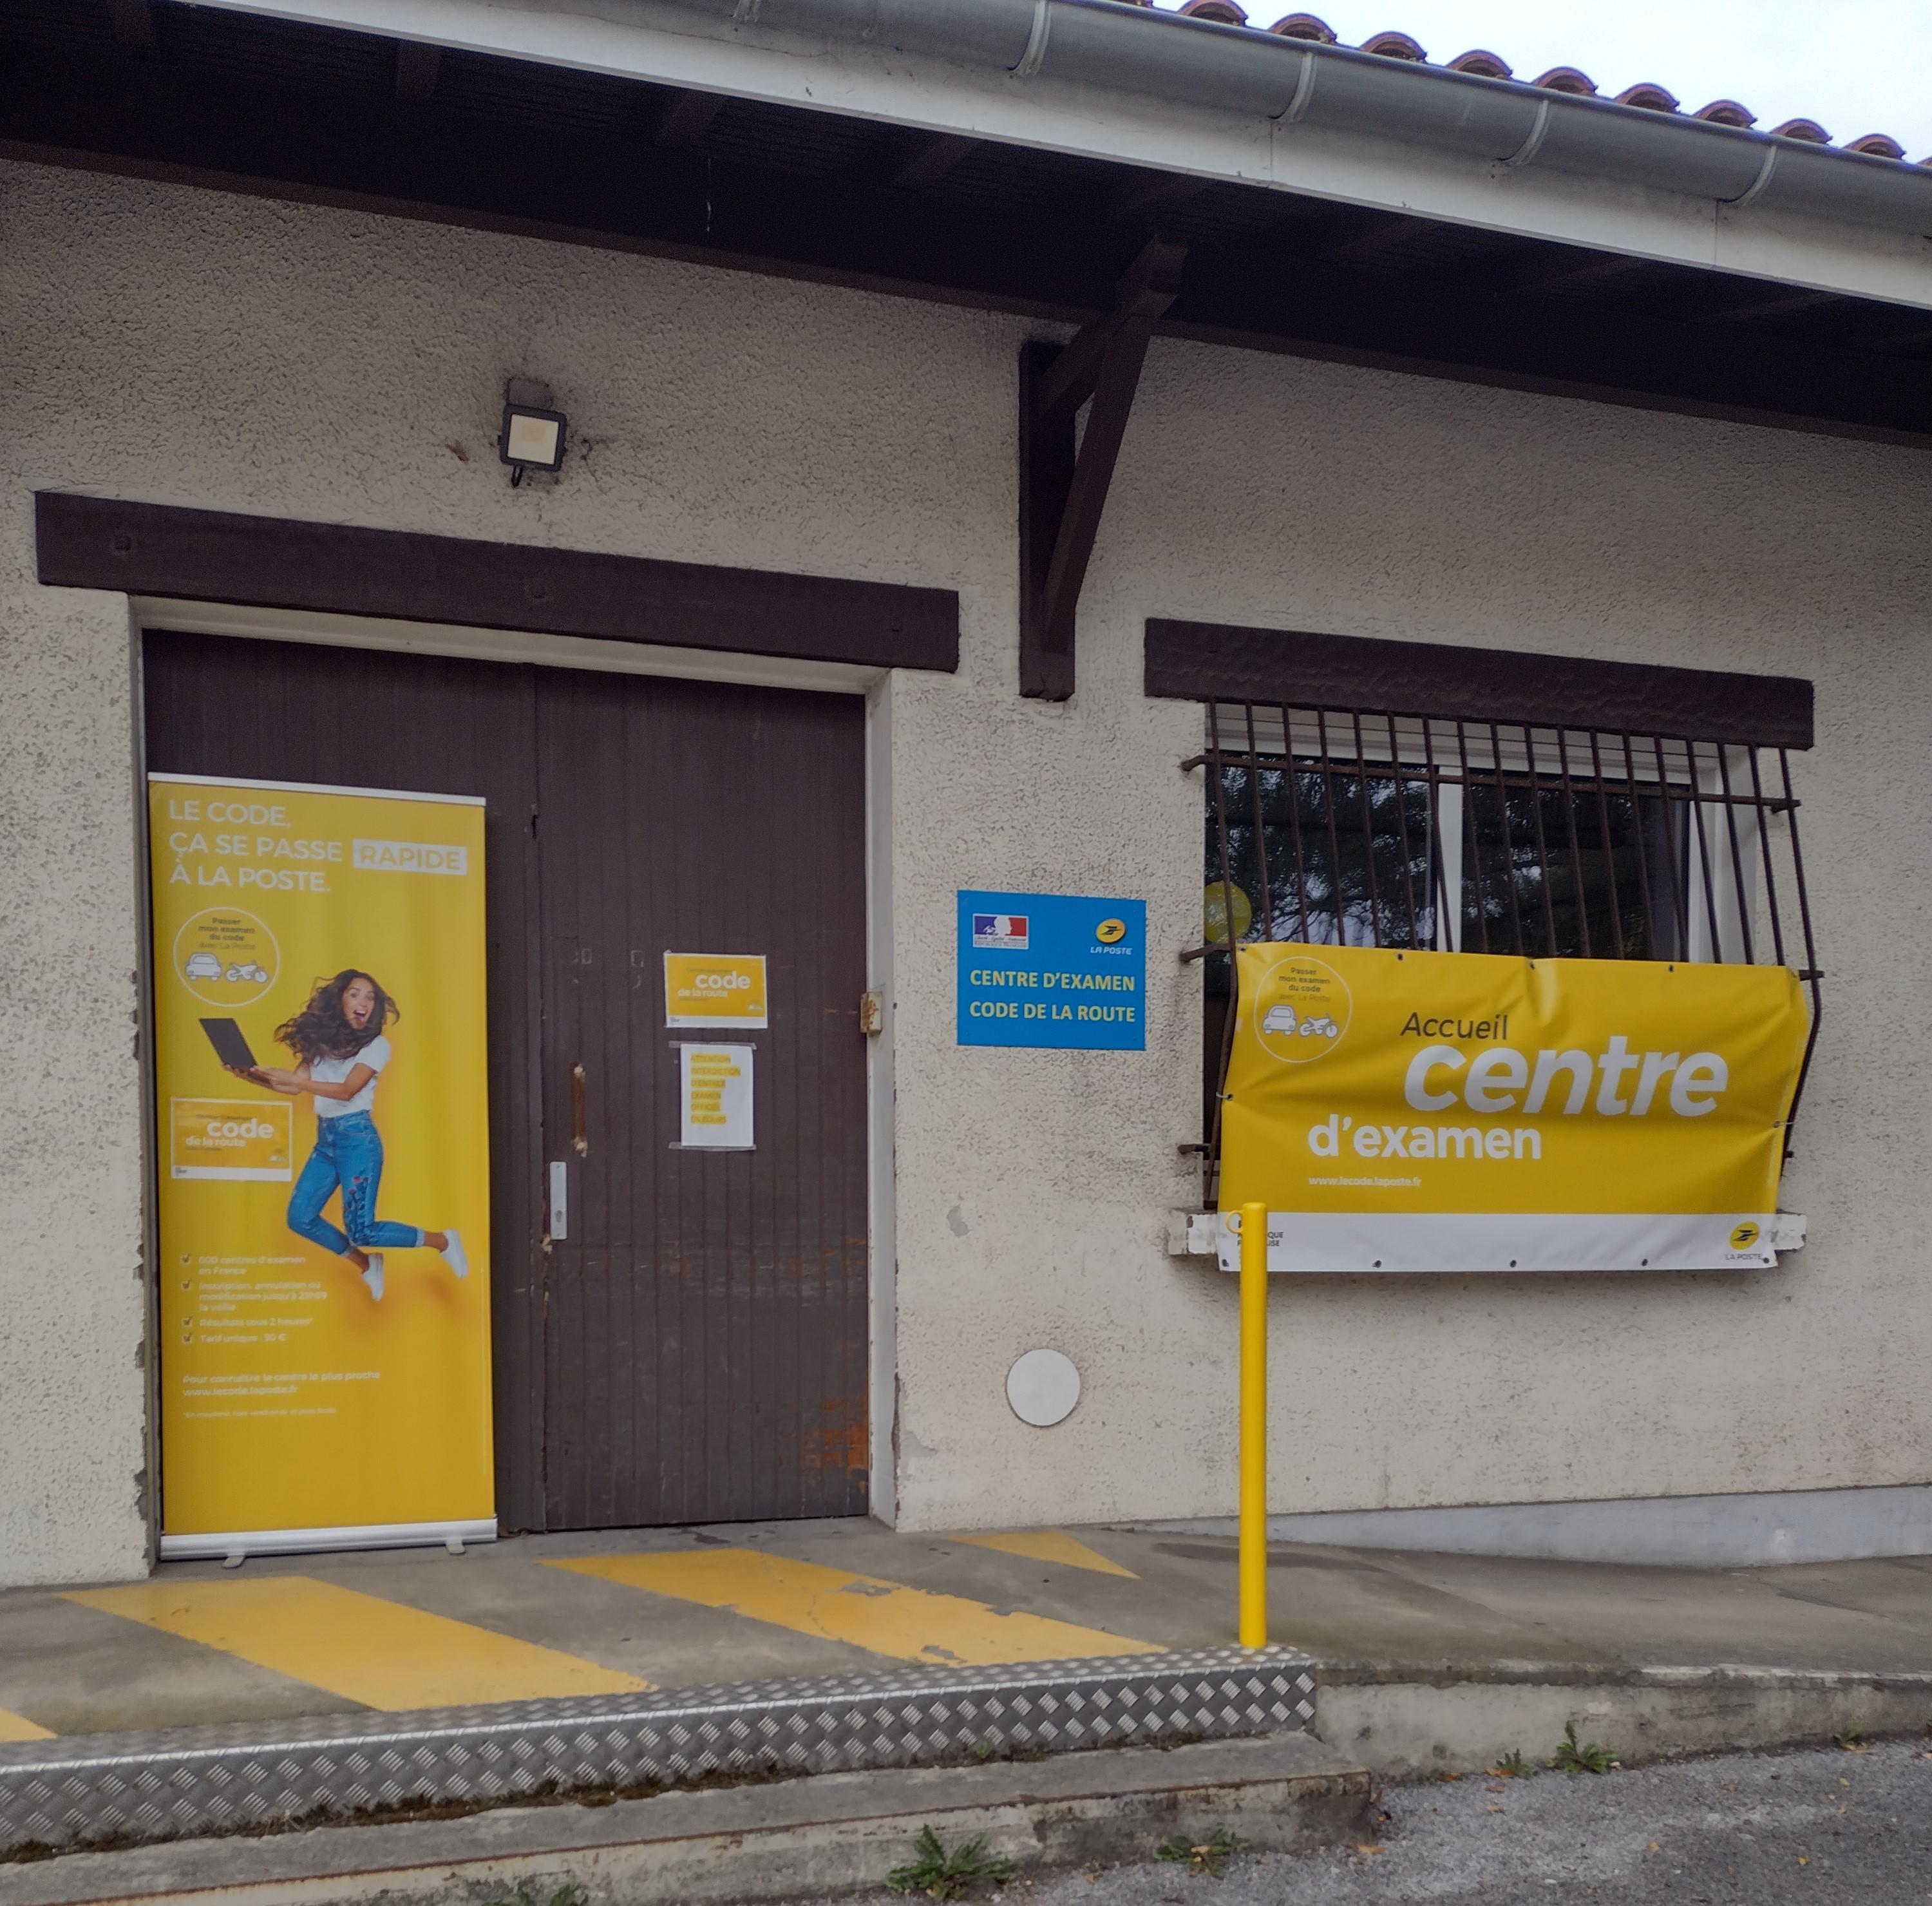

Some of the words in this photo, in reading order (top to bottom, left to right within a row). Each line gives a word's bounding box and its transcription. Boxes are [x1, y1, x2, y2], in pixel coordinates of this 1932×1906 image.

[169, 799, 200, 821] LE
[207, 802, 290, 828] CODE,
[169, 832, 208, 857] ÇA
[216, 835, 248, 856] SE
[258, 839, 342, 861] PASSE
[360, 844, 461, 870] RAPIDE
[170, 859, 191, 885] À
[198, 866, 231, 886] LA
[239, 868, 330, 891] POSTE.
[1103, 946, 1133, 955] POSTE
[696, 971, 750, 989] code
[970, 969, 1038, 987] CENTRE
[1043, 973, 1135, 991] D'EXAMEN
[970, 1001, 1018, 1018] CODE
[1024, 1004, 1046, 1019] DE
[1052, 1005, 1073, 1020] LA
[1077, 1005, 1135, 1022] ROUTE
[1400, 1012, 1508, 1040] Accueil
[1405, 1035, 1728, 1117] centre
[207, 1118, 274, 1139] code
[1308, 1114, 1541, 1159] d'examen
